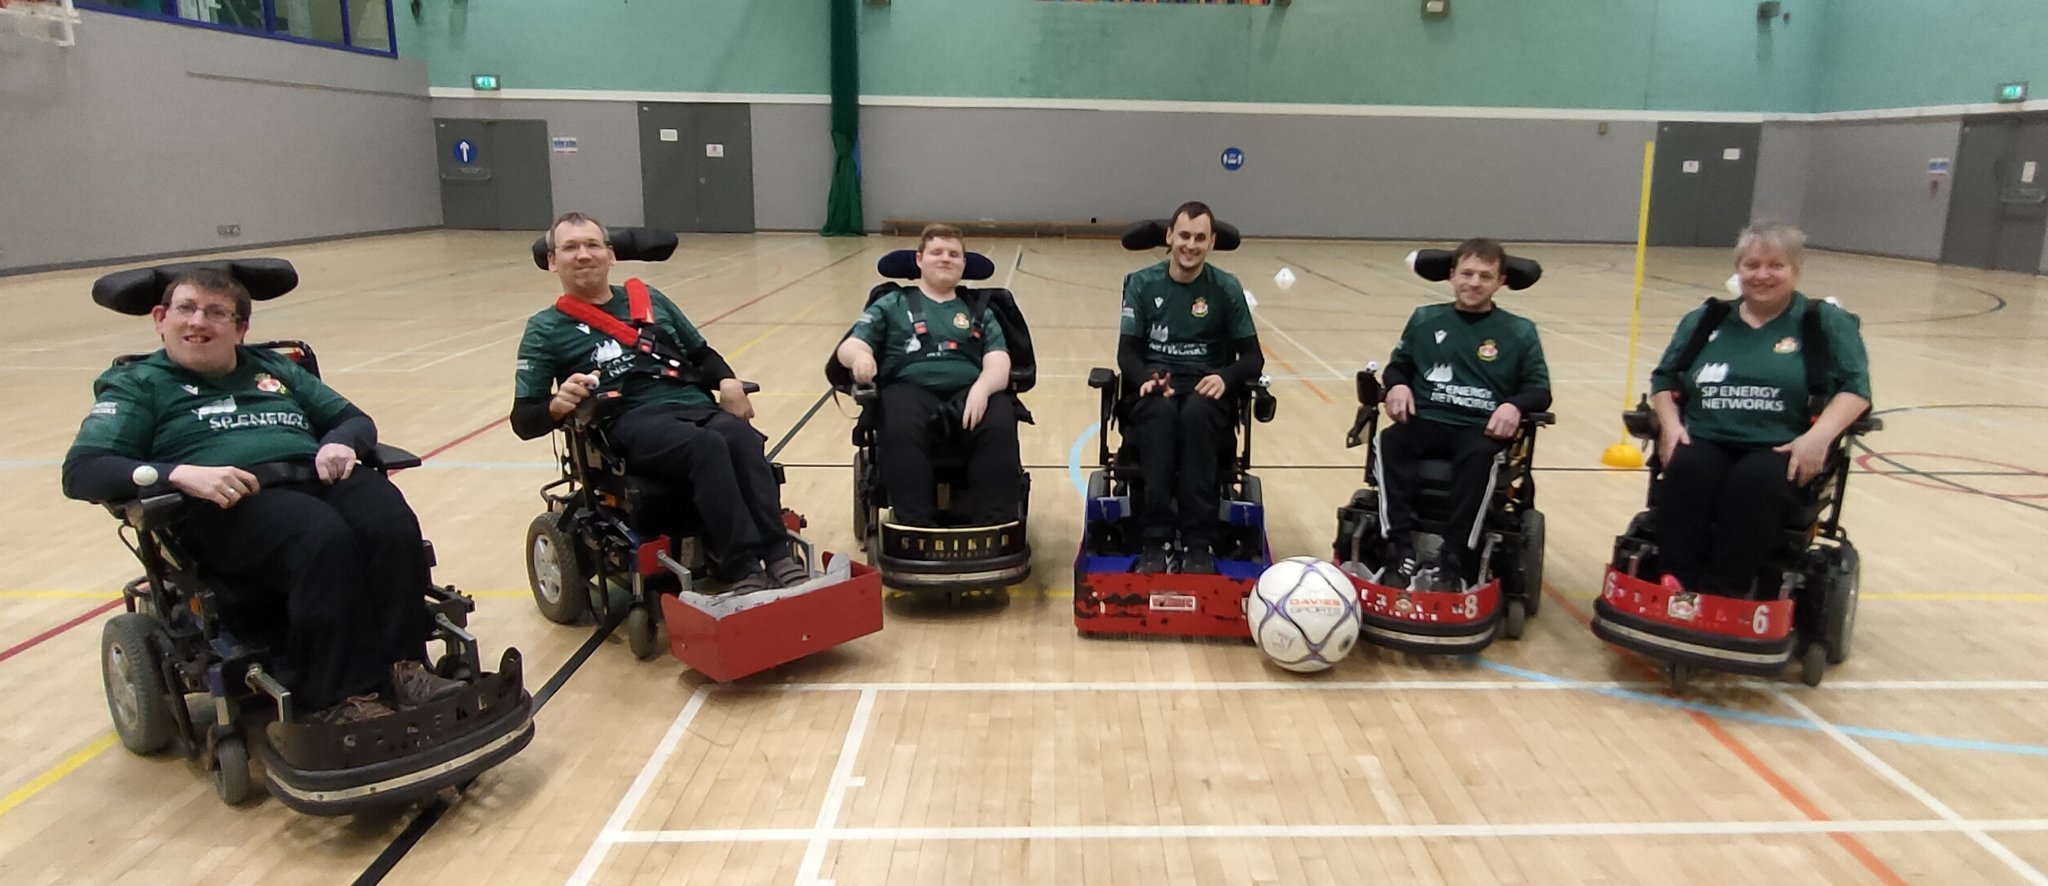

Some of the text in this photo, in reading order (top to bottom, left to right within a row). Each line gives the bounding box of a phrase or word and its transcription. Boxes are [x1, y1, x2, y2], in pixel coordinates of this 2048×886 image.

[1445, 385, 1492, 399] ENERGY
[1701, 386, 1780, 398] SP ENERGY
[1430, 392, 1497, 411] NETWORKS
[1701, 398, 1784, 412] NETWORKS
[1289, 598, 1341, 606] DAVIES
[1464, 595, 1478, 619] 8
[1752, 605, 1769, 634] 6
